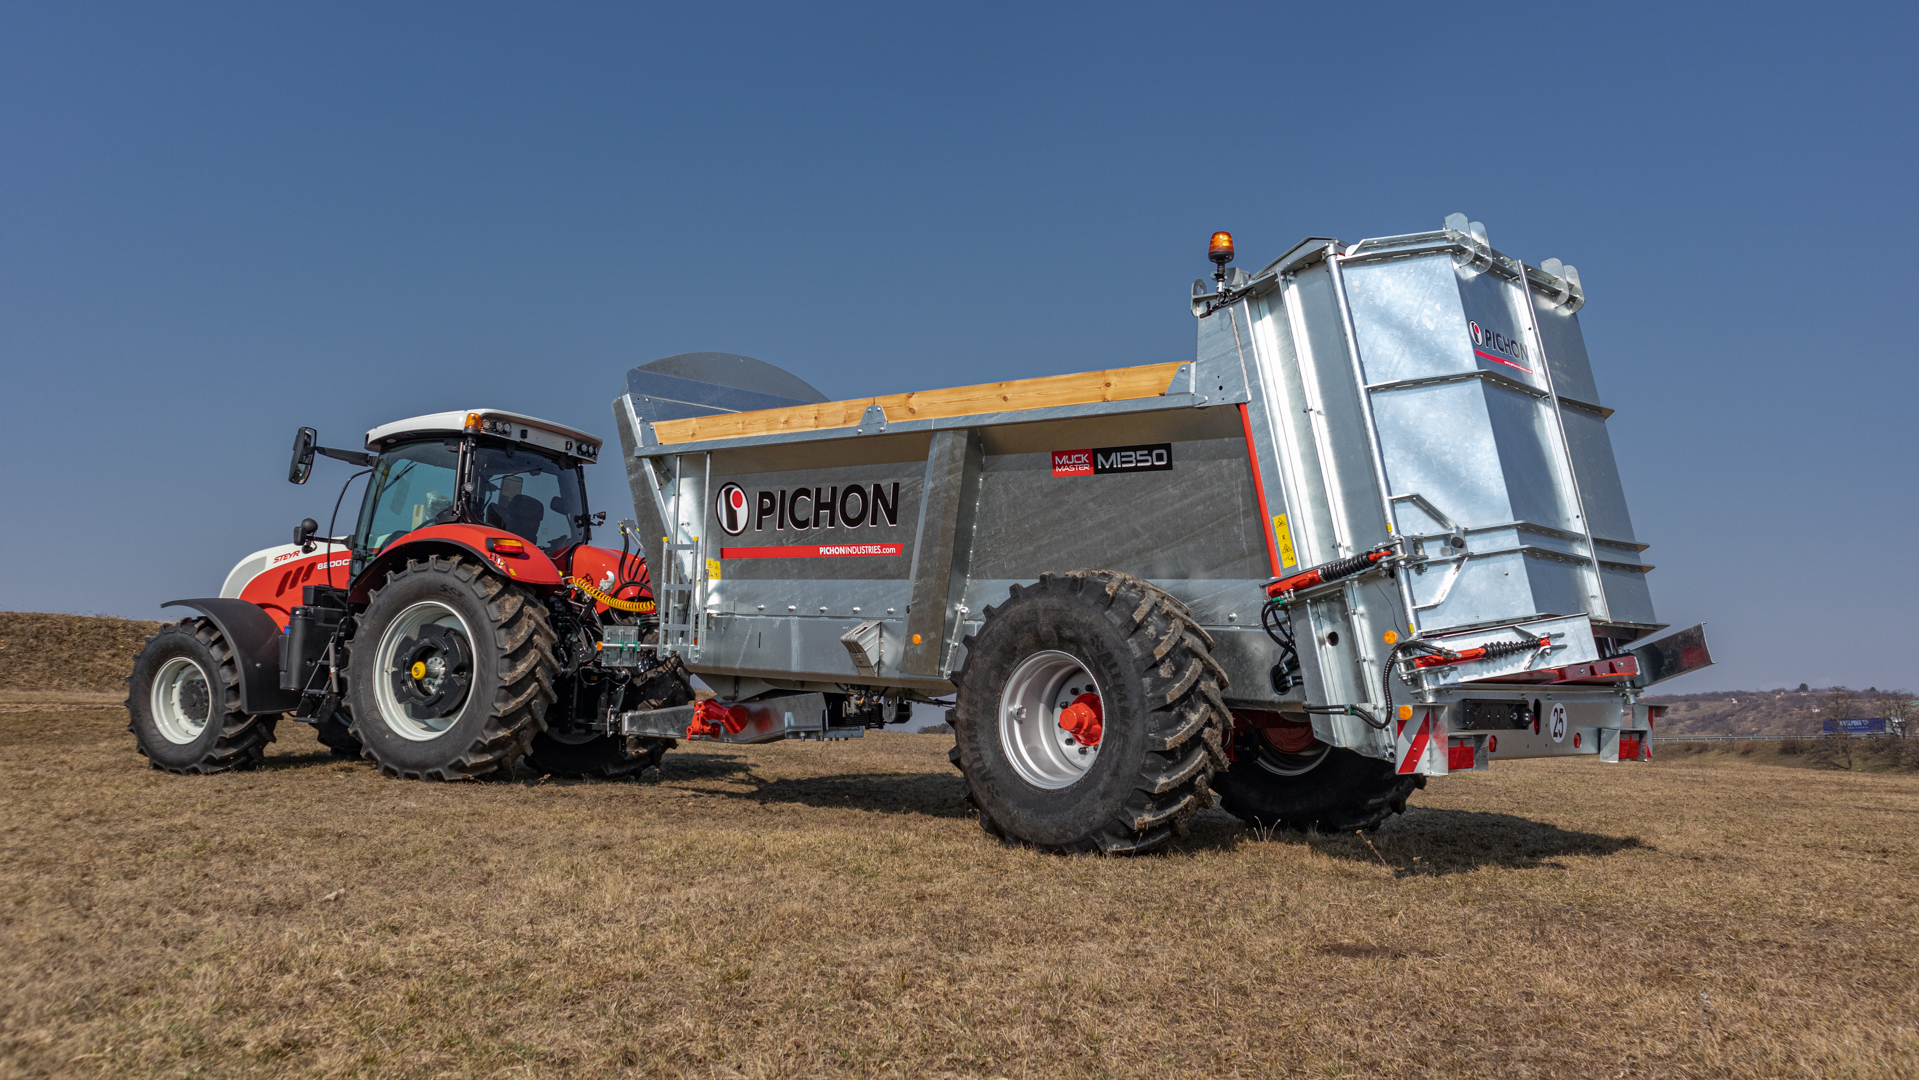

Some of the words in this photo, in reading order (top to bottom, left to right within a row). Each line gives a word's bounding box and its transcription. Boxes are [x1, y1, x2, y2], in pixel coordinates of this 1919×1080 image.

[1484, 328, 1530, 362] PICHON
[1055, 453, 1089, 465] MUCK
[1055, 464, 1090, 472] MASTER
[755, 482, 900, 532] PICHON
[273, 550, 300, 564] STEYR
[819, 545, 896, 555] PICHONINDUSTRIES.com
[1553, 707, 1563, 738] 25
